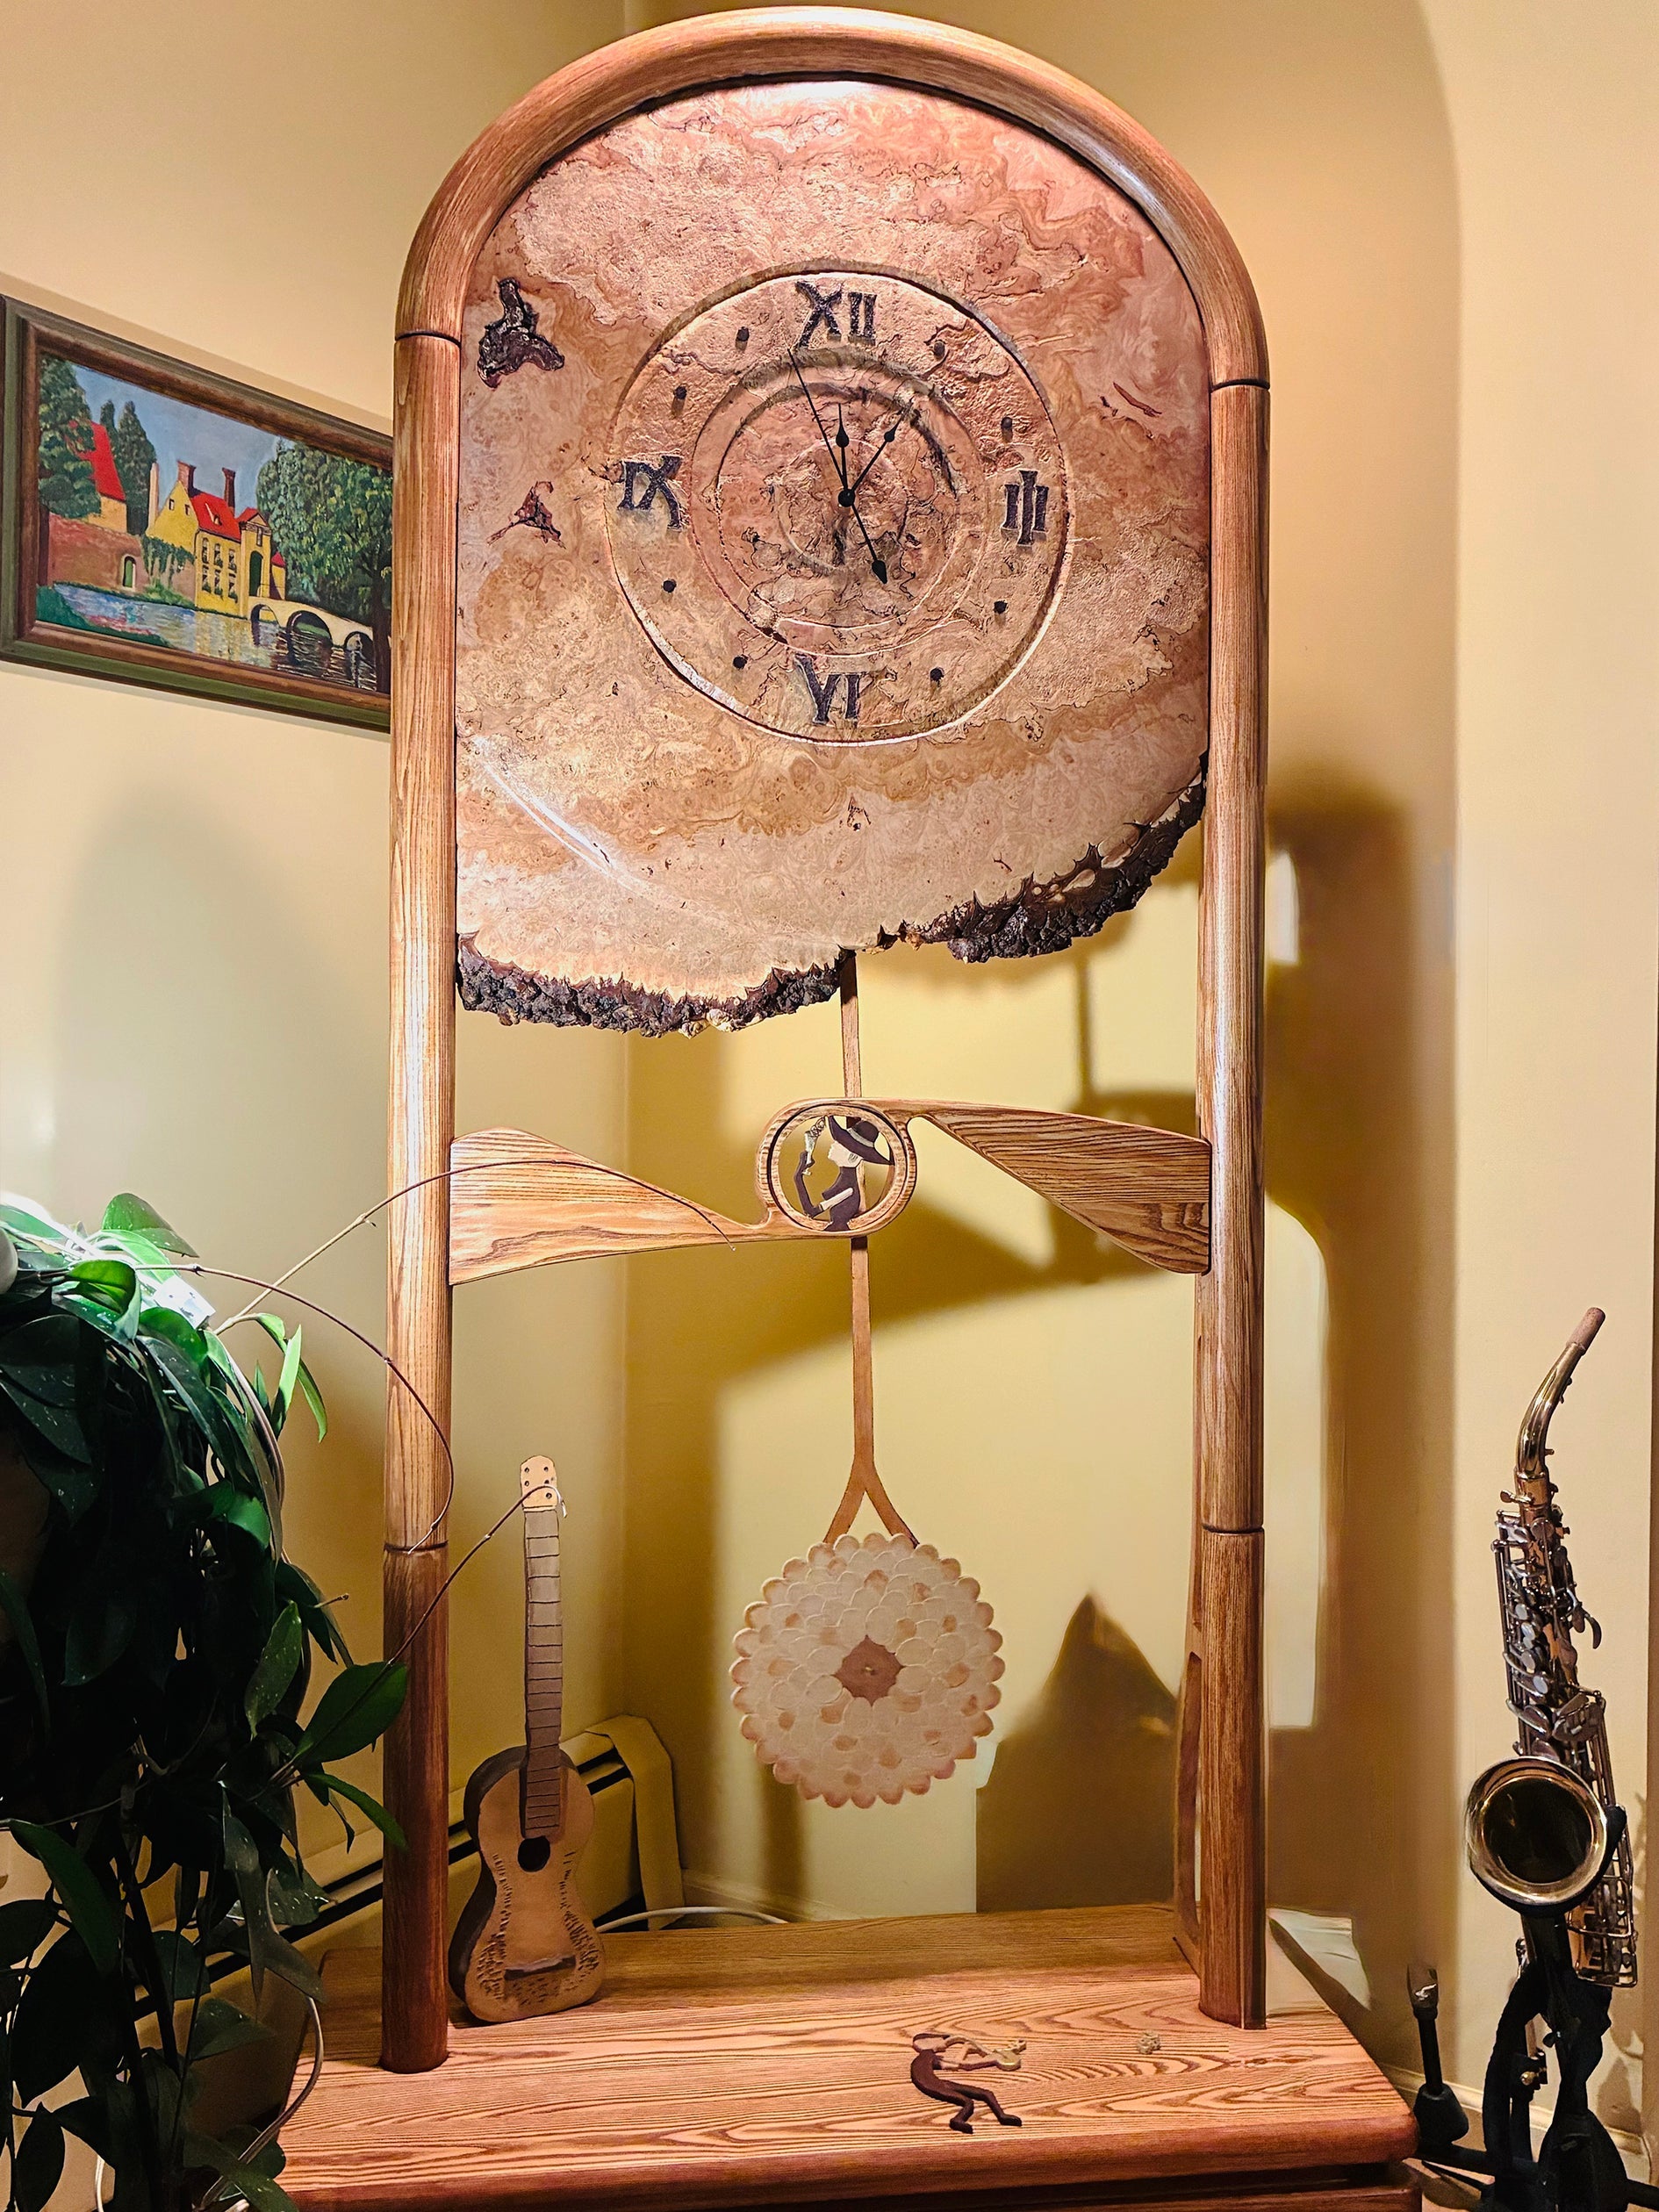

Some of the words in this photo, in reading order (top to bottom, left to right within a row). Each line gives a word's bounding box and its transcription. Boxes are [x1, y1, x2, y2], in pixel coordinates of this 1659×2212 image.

[794, 281, 877, 350] XII
[618, 456, 682, 529] IX
[1001, 470, 1049, 546] III
[794, 654, 860, 726] VI
